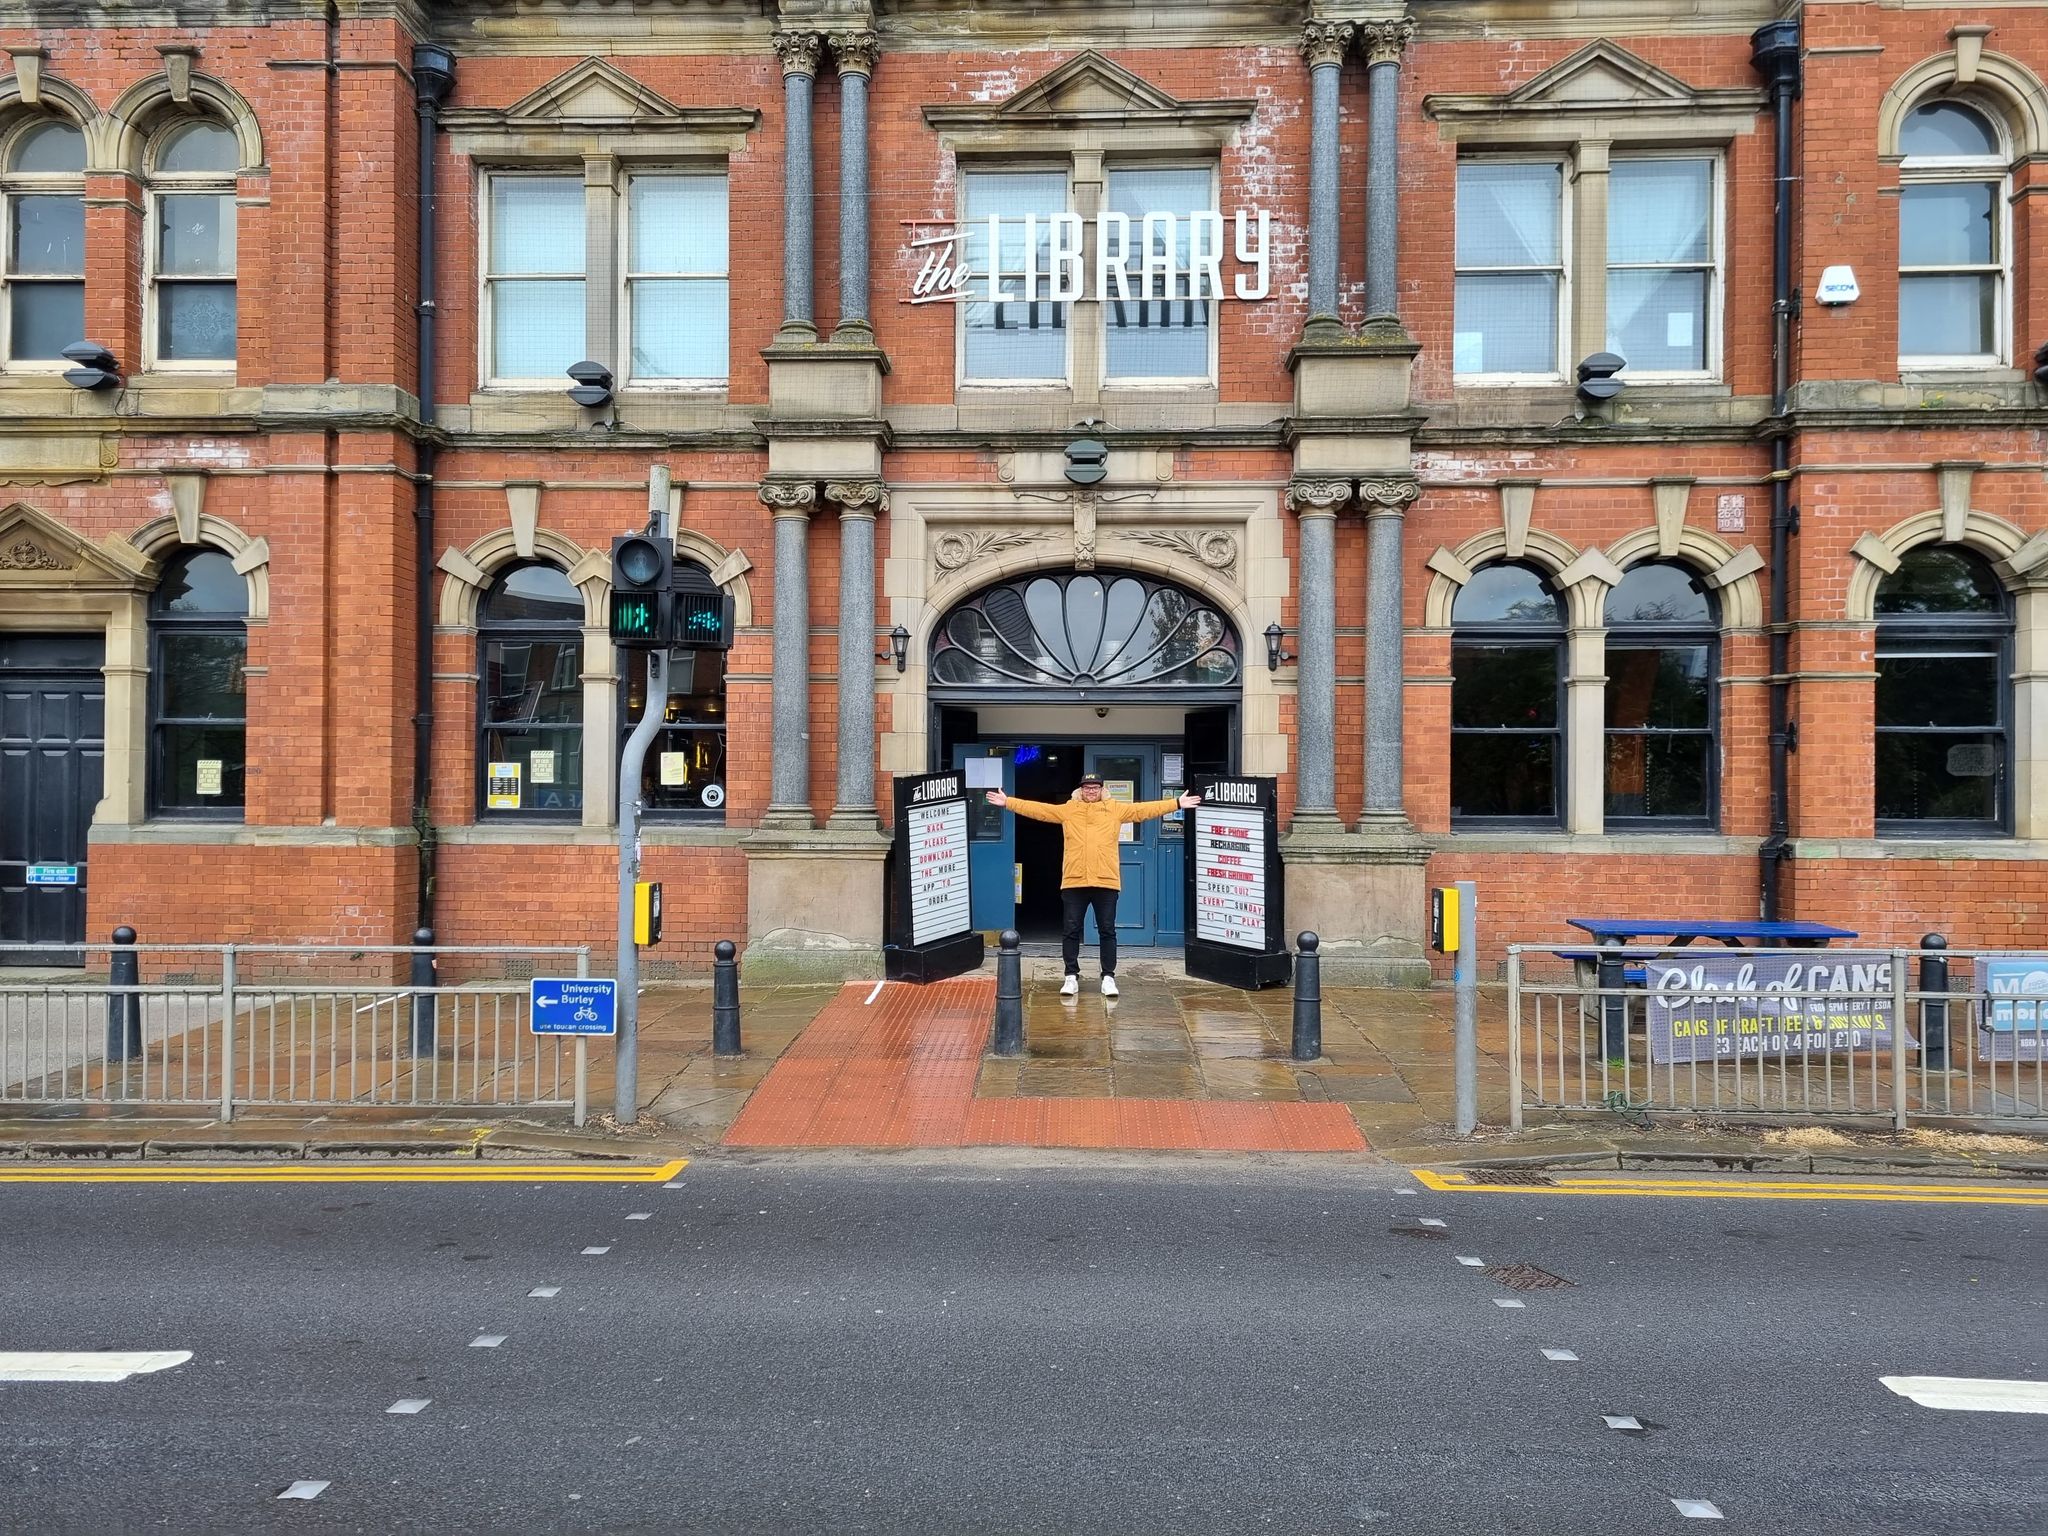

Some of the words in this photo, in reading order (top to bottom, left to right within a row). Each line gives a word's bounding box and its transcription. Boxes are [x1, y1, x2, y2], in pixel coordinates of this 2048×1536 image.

[911, 237, 974, 301] the
[988, 209, 1270, 303] LIBRARY
[922, 776, 957, 801] LIBRARY
[1215, 781, 1257, 804] LIBRARY
[920, 807, 950, 820] WELCOME
[926, 822, 944, 833] BACK
[1228, 827, 1249, 839] PHONE
[924, 836, 948, 848] PLEASE
[920, 849, 953, 864] DOWNLOAD
[1217, 854, 1242, 866] COFFEE
[921, 868, 932, 879] THE
[938, 863, 956, 874] MORE
[923, 882, 935, 892] APP
[942, 878, 951, 888] TO
[1207, 882, 1230, 894] SPEED
[1233, 886, 1250, 897] QUIZ
[928, 893, 948, 906] ORDER
[1203, 896, 1225, 907] EVERY
[1224, 914, 1233, 924] TO
[1241, 917, 1260, 928] PLAY
[561, 984, 612, 995] University
[1656, 963, 1759, 1009] Clash
[1765, 963, 1803, 1011] of
[561, 995, 595, 1006] Burley
[1828, 1001, 1844, 1012] 5PM
[1844, 1001, 1865, 1012] EERY
[1674, 1019, 1709, 1038] CANS
[1793, 1033, 1802, 1050] 4
